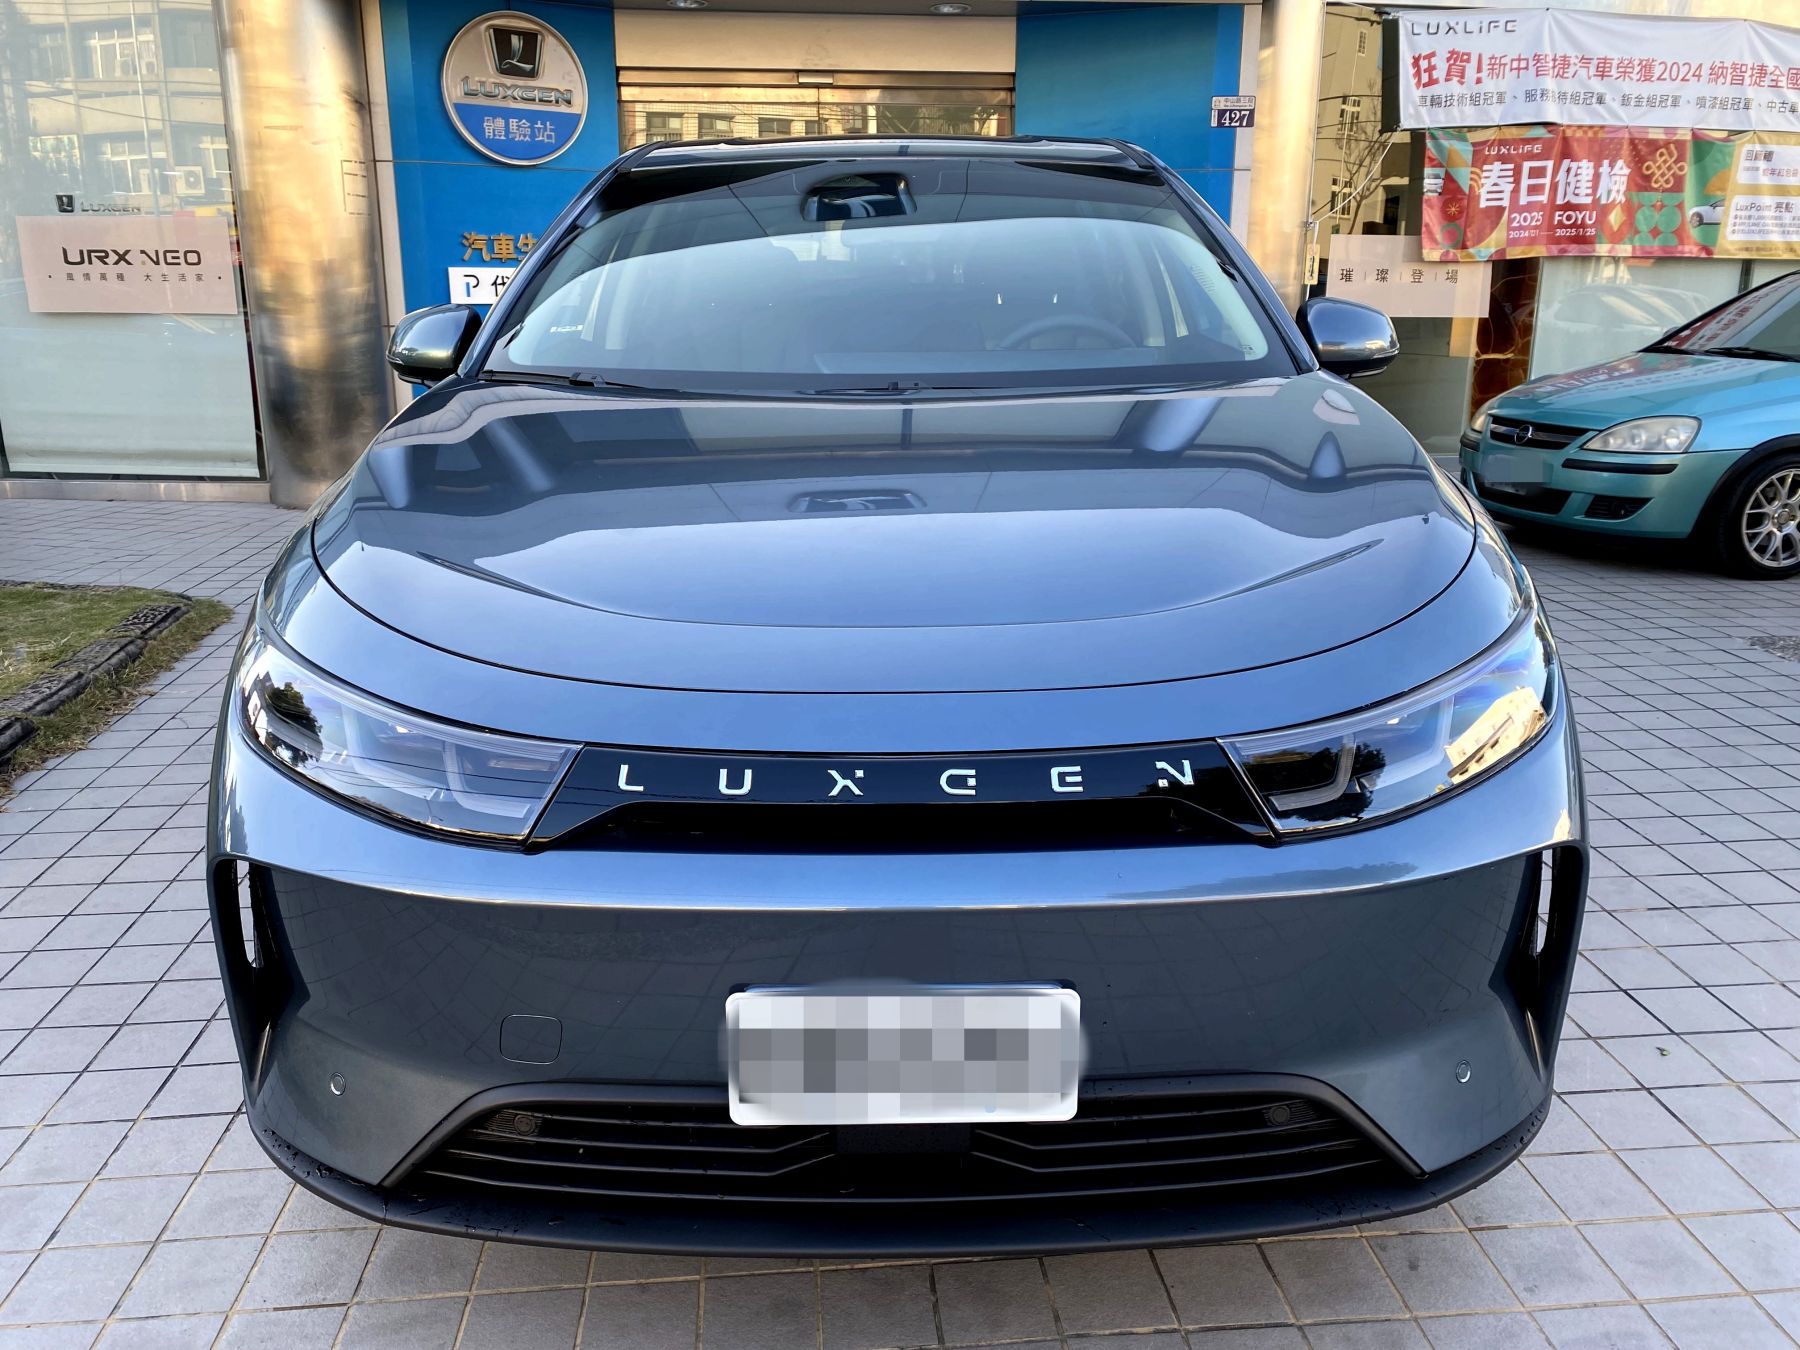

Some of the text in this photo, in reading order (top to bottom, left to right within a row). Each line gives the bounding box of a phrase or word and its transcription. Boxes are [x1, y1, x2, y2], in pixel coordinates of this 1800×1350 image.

[461, 75, 574, 107] LUXGEN
[1221, 110, 1250, 127] 427
[483, 116, 556, 144] 體驗站
[1478, 159, 1632, 208] 春日健檢
[1511, 211, 1597, 227] 2025 FOYU
[1555, 228, 1597, 236] 2025/1/25
[62, 246, 202, 266] URX NEO
[66, 273, 205, 282] 風情萬種 大生活家
[617, 759, 1194, 797] LUXGEN
